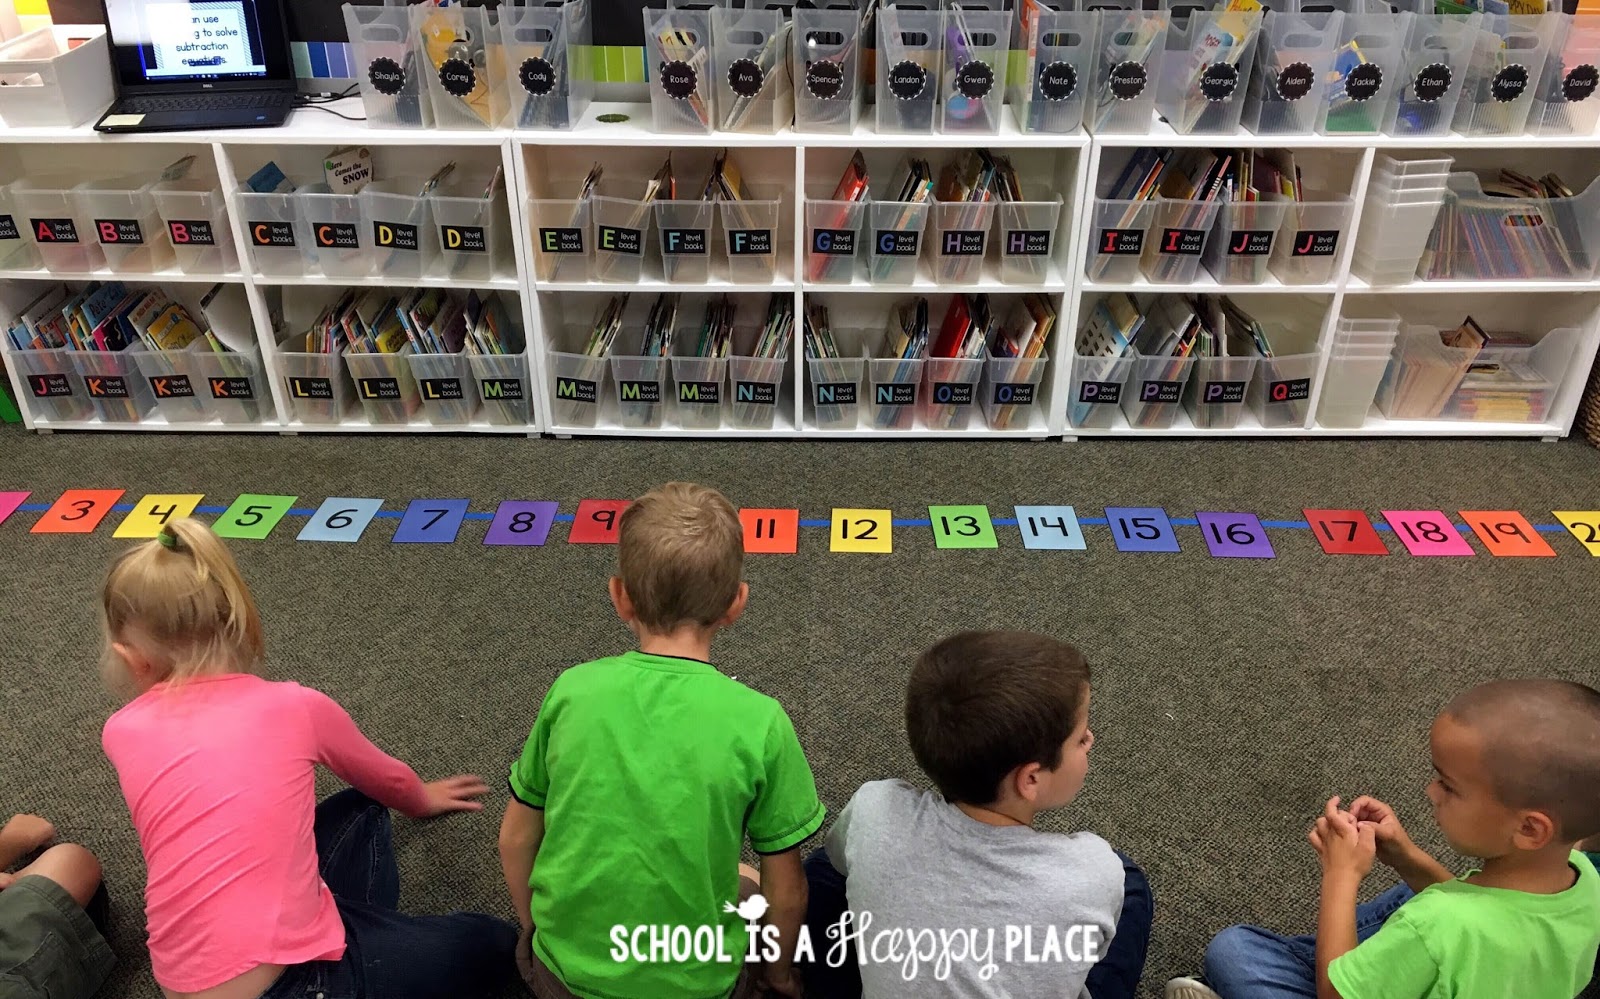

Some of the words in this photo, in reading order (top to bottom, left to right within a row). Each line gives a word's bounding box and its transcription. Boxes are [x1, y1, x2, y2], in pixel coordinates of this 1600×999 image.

[203, 28, 212, 36] to
[216, 26, 238, 36] solve
[176, 42, 228, 51] subtraction
[375, 72, 399, 81] Shayla
[446, 72, 468, 84] Corey
[528, 72, 546, 82] Cody
[670, 76, 689, 84] Rose
[738, 74, 753, 82] Ava
[811, 75, 839, 86] Spencer
[894, 76, 920, 84] Landon
[964, 76, 986, 84] Gwen
[1049, 76, 1068, 85] Nate
[1114, 76, 1142, 84] Preston
[1205, 77, 1234, 87] Georgia
[1286, 77, 1306, 86] Aiden
[1352, 77, 1375, 87] Jackie
[1422, 78, 1444, 86] Ethan
[1498, 79, 1522, 89] Alyssa
[1570, 78, 1591, 86] David
[343, 168, 369, 185] SNOW
[38, 222, 56, 240] A
[100, 222, 118, 241] B
[171, 223, 189, 242] B
[192, 233, 212, 241] books
[254, 225, 270, 244] C
[319, 226, 334, 245] C
[379, 225, 392, 244] D
[397, 229, 413, 237] level
[447, 228, 461, 247] D
[603, 230, 615, 248] E
[620, 233, 636, 241] level
[337, 237, 357, 245] books
[545, 232, 558, 250] E
[618, 241, 638, 250] books
[669, 232, 680, 251] F
[684, 242, 703, 250] books
[735, 233, 746, 251] F
[751, 242, 769, 250] books
[816, 233, 831, 250] G
[832, 243, 851, 251] books
[880, 233, 894, 251] G
[896, 243, 915, 251] books
[947, 234, 961, 252] H
[1010, 234, 1025, 252] H
[1104, 232, 1118, 251] I
[1166, 232, 1180, 250] I
[1232, 234, 1248, 253] J
[1298, 235, 1313, 253] J
[36, 378, 48, 395] J
[90, 378, 105, 395] K
[154, 379, 171, 396] K
[212, 380, 228, 396] K
[295, 380, 308, 397] L
[363, 381, 377, 398] L
[426, 381, 440, 398] L
[484, 382, 503, 397] M
[558, 380, 577, 398] M
[622, 383, 641, 399] M
[681, 384, 700, 400] M
[738, 384, 753, 400] N
[819, 386, 834, 402] N
[878, 386, 893, 402] N
[938, 386, 952, 402] O
[998, 386, 1012, 401] O
[1083, 384, 1098, 399] P
[1143, 384, 1159, 399] P
[1207, 385, 1223, 400] P
[1273, 384, 1286, 399] Q
[61, 500, 95, 521] 3
[148, 504, 177, 524] 4
[235, 506, 272, 526] 5
[325, 509, 358, 529] 6
[421, 509, 449, 530] 7
[508, 512, 536, 533] 8
[592, 510, 616, 530] 9
[940, 515, 981, 536] 13
[1028, 516, 1068, 537] 14
[756, 518, 775, 539] 11
[842, 519, 878, 539] 12
[1118, 517, 1161, 540] 15
[1210, 522, 1255, 545] 16
[1318, 520, 1358, 542] 17
[1401, 521, 1448, 543] 18
[1479, 522, 1532, 544] 19
[1570, 522, 1600, 543] 2
